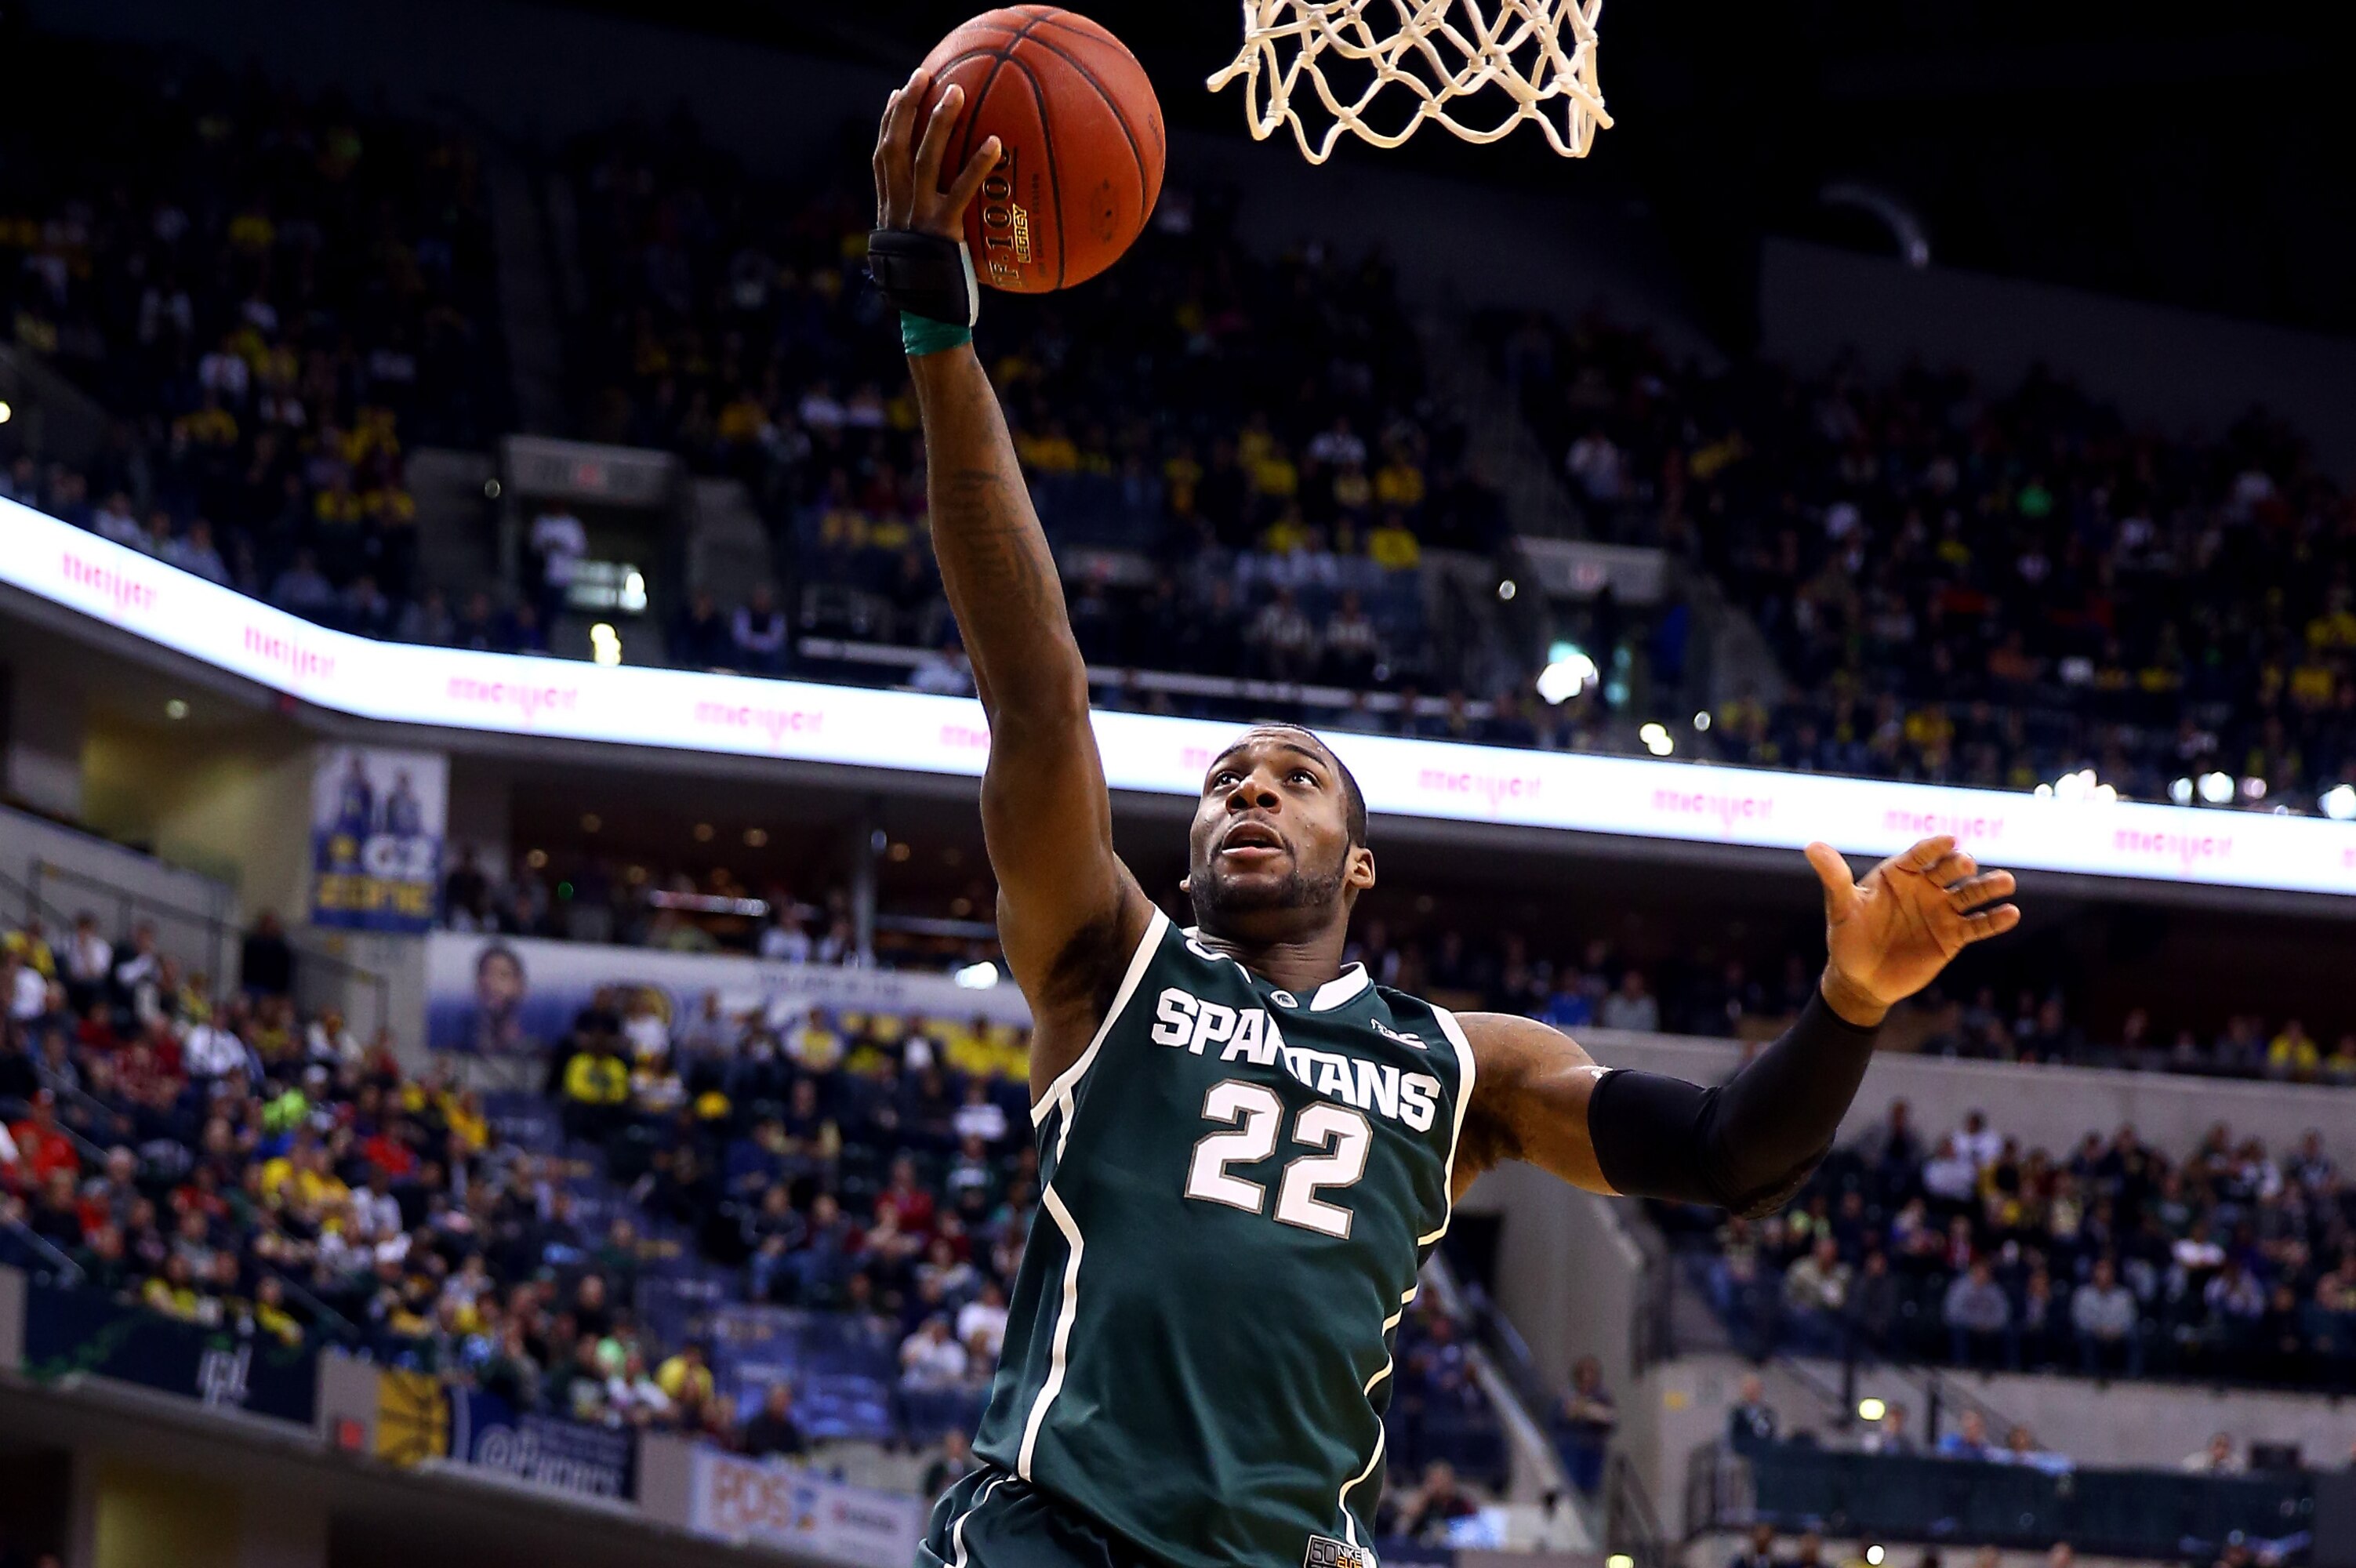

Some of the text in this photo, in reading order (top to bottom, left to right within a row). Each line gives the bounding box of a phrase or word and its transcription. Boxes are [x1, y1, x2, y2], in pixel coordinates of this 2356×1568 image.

[1184, 1078, 1374, 1240] 22
[1312, 1541, 1363, 1564] 50 NIKE
